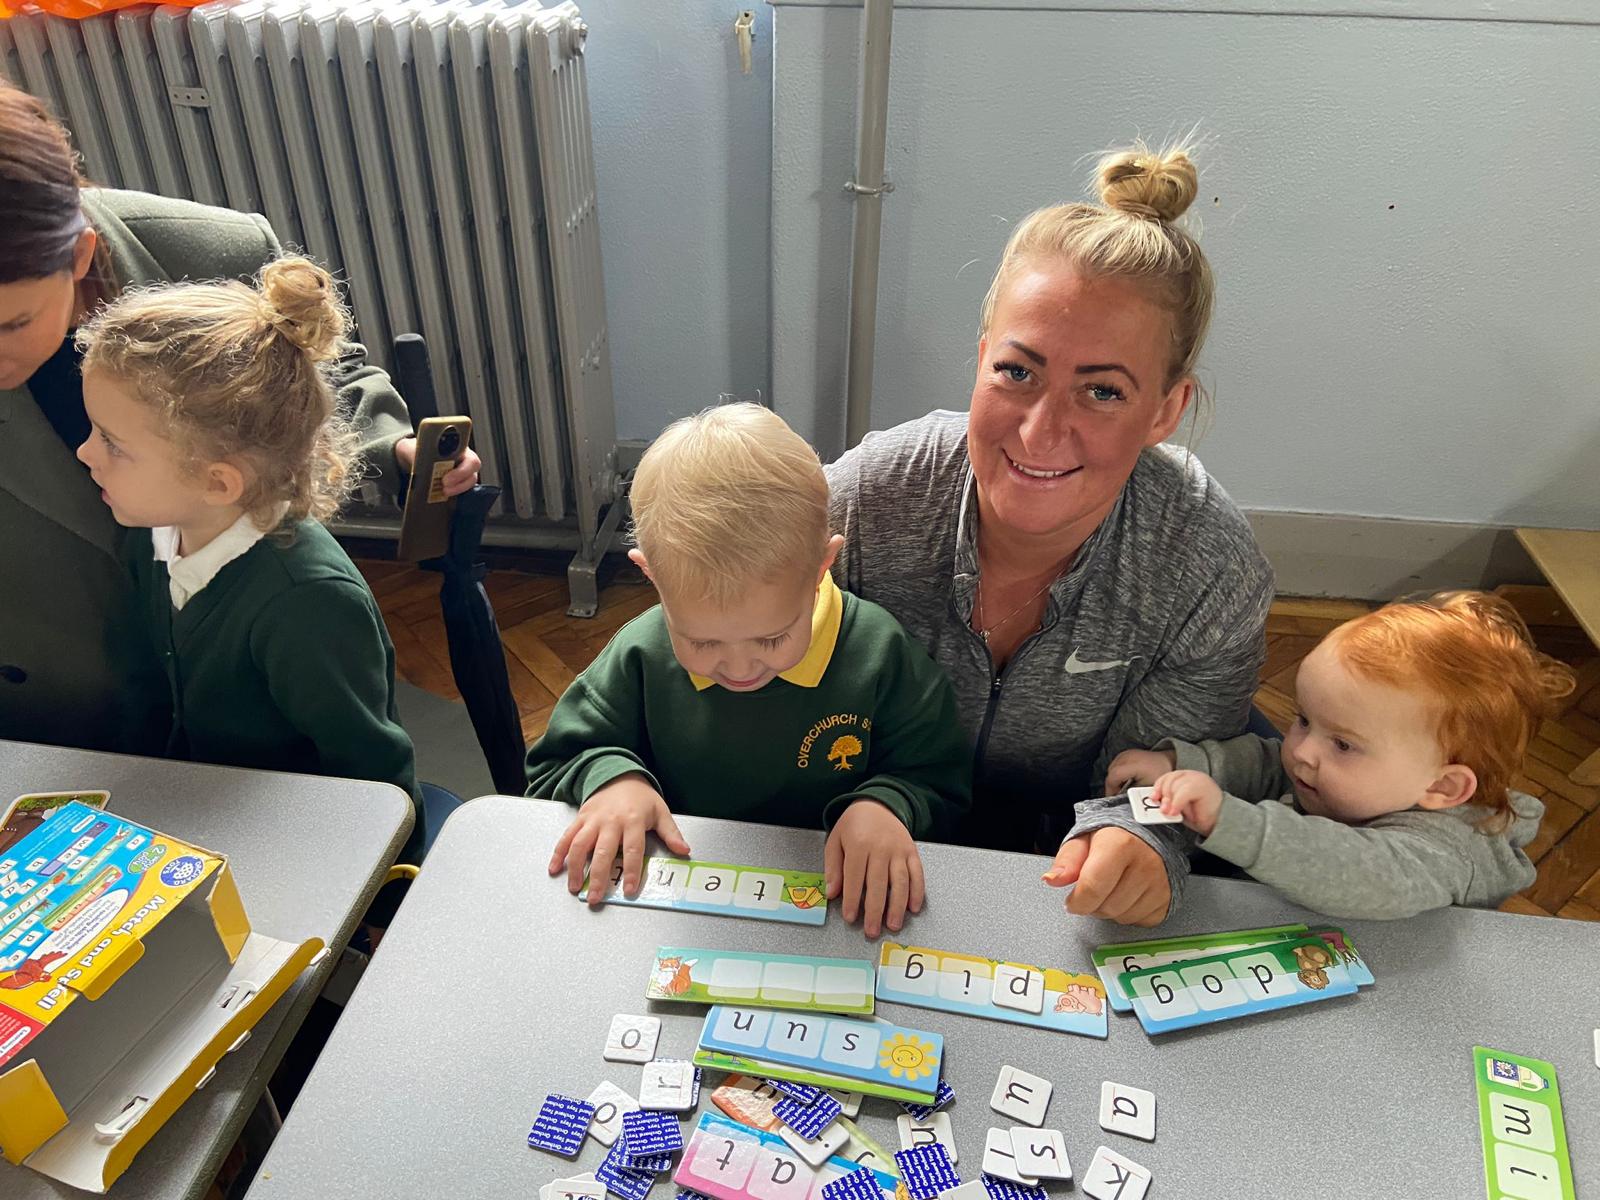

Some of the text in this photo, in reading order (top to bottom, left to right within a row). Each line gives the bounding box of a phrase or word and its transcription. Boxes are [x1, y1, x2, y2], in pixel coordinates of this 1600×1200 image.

[797, 713, 858, 768] OVERCHURCH
[111, 896, 165, 939] Match
[80, 938, 113, 967] and
[905, 953, 1031, 997] pig
[1150, 963, 1274, 1004] dog
[621, 1028, 642, 1050] o
[732, 1010, 860, 1051] sun
[780, 1084, 791, 1093] Toys
[791, 1090, 811, 1103] Orchard
[804, 1089, 815, 1097] Toys
[554, 1110, 575, 1119] Orchard
[806, 1105, 817, 1114] Toys
[822, 1100, 833, 1109] Toys
[1112, 1096, 1138, 1118] a
[535, 1121, 546, 1129] Toys
[806, 1109, 823, 1126] Orchard
[818, 1114, 829, 1123] Toys
[547, 1125, 568, 1134] Orchard
[552, 1134, 564, 1142] Toys
[528, 1136, 577, 1154] Toys Orchard Toys
[642, 1142, 664, 1150] Orchard
[1031, 1144, 1056, 1160] s
[1503, 1104, 1549, 1180] mi
[716, 1140, 796, 1184] at
[902, 1153, 914, 1173] Orchard
[911, 1153, 919, 1165] Toys
[917, 1150, 936, 1184] Toys Orchard
[926, 1150, 943, 1183] Orchard Toys
[932, 1146, 951, 1181] Toys Orchard
[598, 1172, 609, 1181] Toys
[611, 1179, 632, 1195] Orchard
[602, 1163, 634, 1185] Orchard Toys
[900, 1168, 912, 1190] Orchard
[916, 1165, 928, 1186] Orchard
[1104, 1163, 1131, 1200] k
[859, 1185, 867, 1198] Toys
